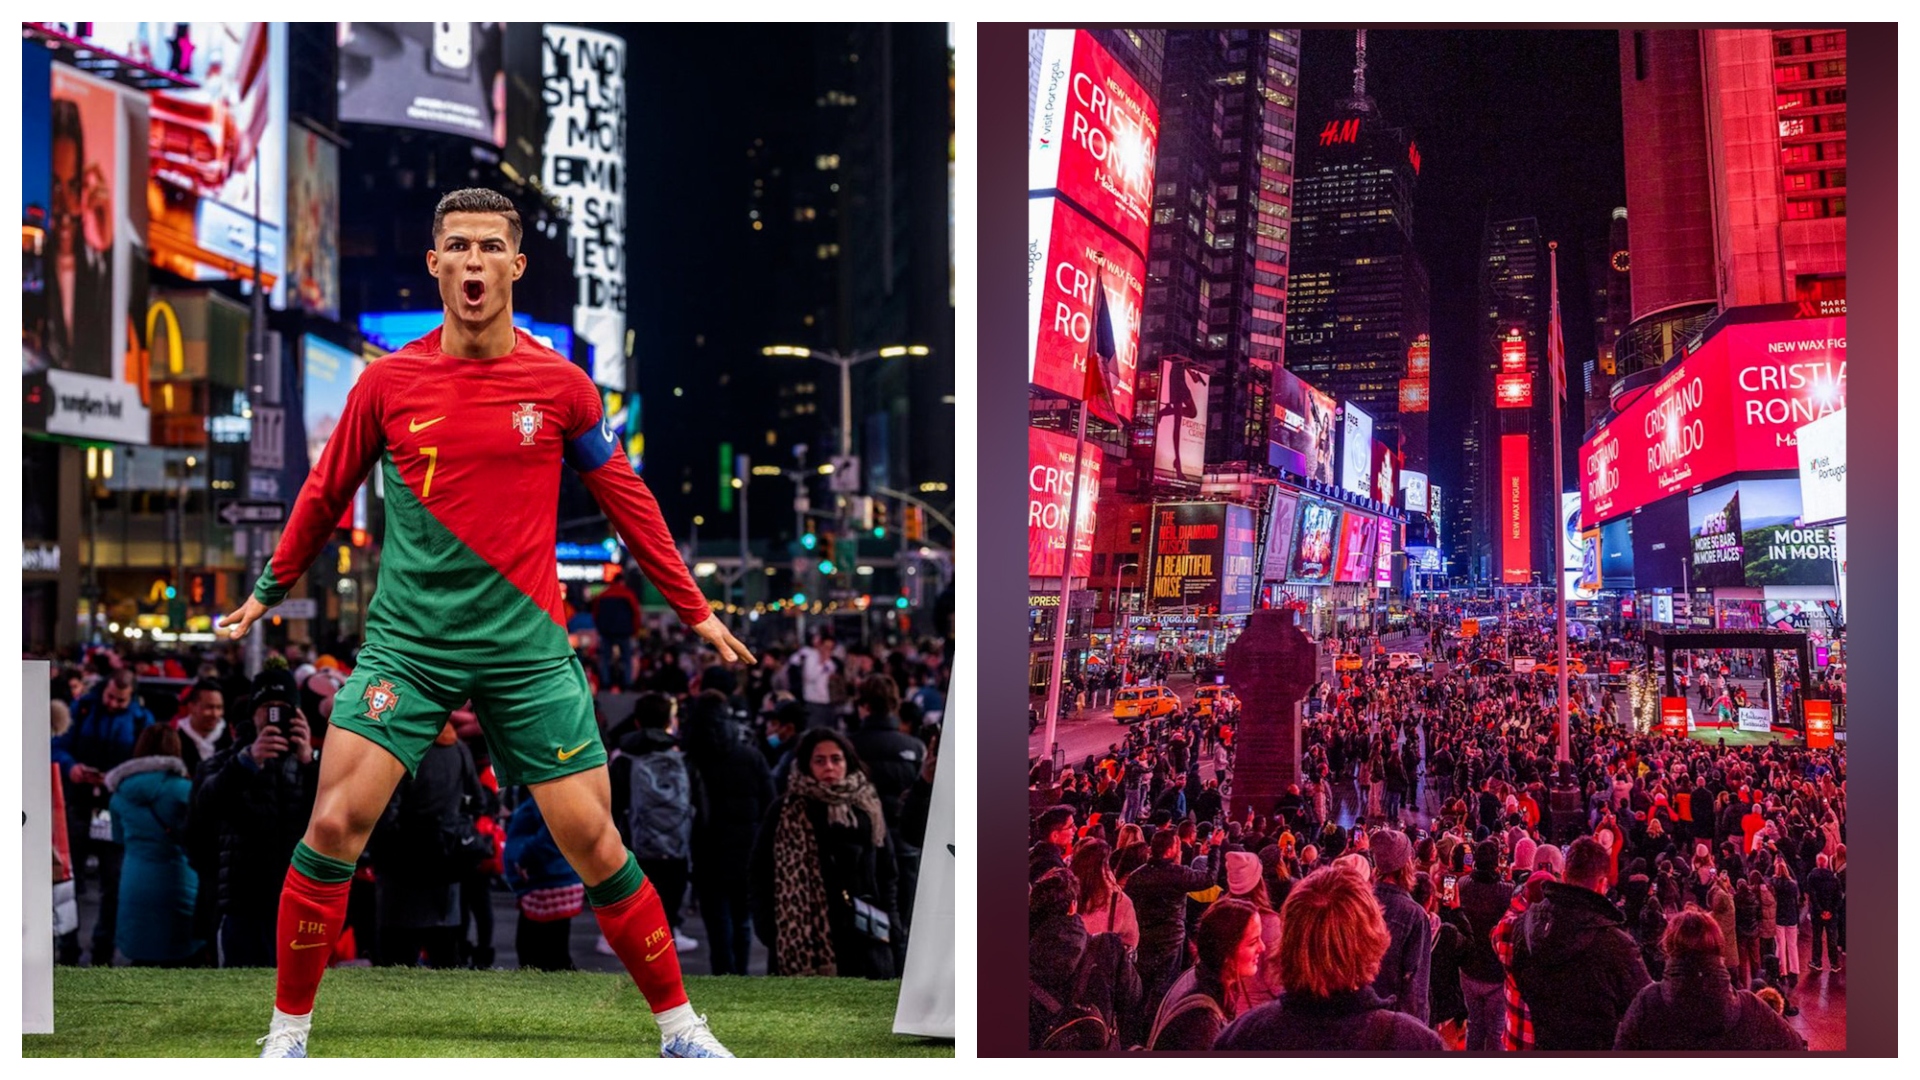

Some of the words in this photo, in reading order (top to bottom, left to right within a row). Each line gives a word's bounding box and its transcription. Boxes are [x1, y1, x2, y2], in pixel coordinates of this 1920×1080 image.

[1045, 59, 1065, 111] portugal
[1106, 76, 1125, 99] NEW
[1124, 91, 1142, 117] WAX
[1042, 111, 1054, 135] visit
[1073, 72, 1156, 174] CRISTIAN
[1320, 118, 1360, 146] H&M
[1106, 260, 1126, 279] WAX
[1768, 341, 1797, 354] NEW
[1797, 339, 1826, 352] WAX
[1645, 377, 1703, 439] CRISTIANO
[1347, 412, 1358, 427] FACE
[1647, 418, 1704, 473] RONALDO
[1058, 452, 1075, 464] NEW
[419, 447, 438, 498] 7
[1512, 476, 1520, 502] FIGURE
[1342, 488, 1400, 519] BROADWAY
[1513, 503, 1521, 519] WAX
[1161, 511, 1175, 526] THE
[1159, 525, 1177, 540] NEIL
[1178, 524, 1219, 540] DIAMOND
[1513, 520, 1521, 539] NEW
[1774, 529, 1826, 545] MORE
[1828, 529, 1836, 544] 5
[1694, 536, 1711, 551] MORE
[1711, 534, 1720, 548] 5G
[1719, 531, 1736, 548] BARS
[1693, 552, 1700, 565] IN
[1700, 550, 1717, 564] MORE
[1717, 547, 1740, 563] PLACES
[1768, 545, 1787, 560] IN
[1791, 544, 1837, 560] MORE
[1155, 555, 1162, 576] A
[1163, 554, 1213, 577] BEAUTIFUL
[1153, 576, 1182, 598] NOISE
[1157, 615, 1199, 624] LUGGGE
